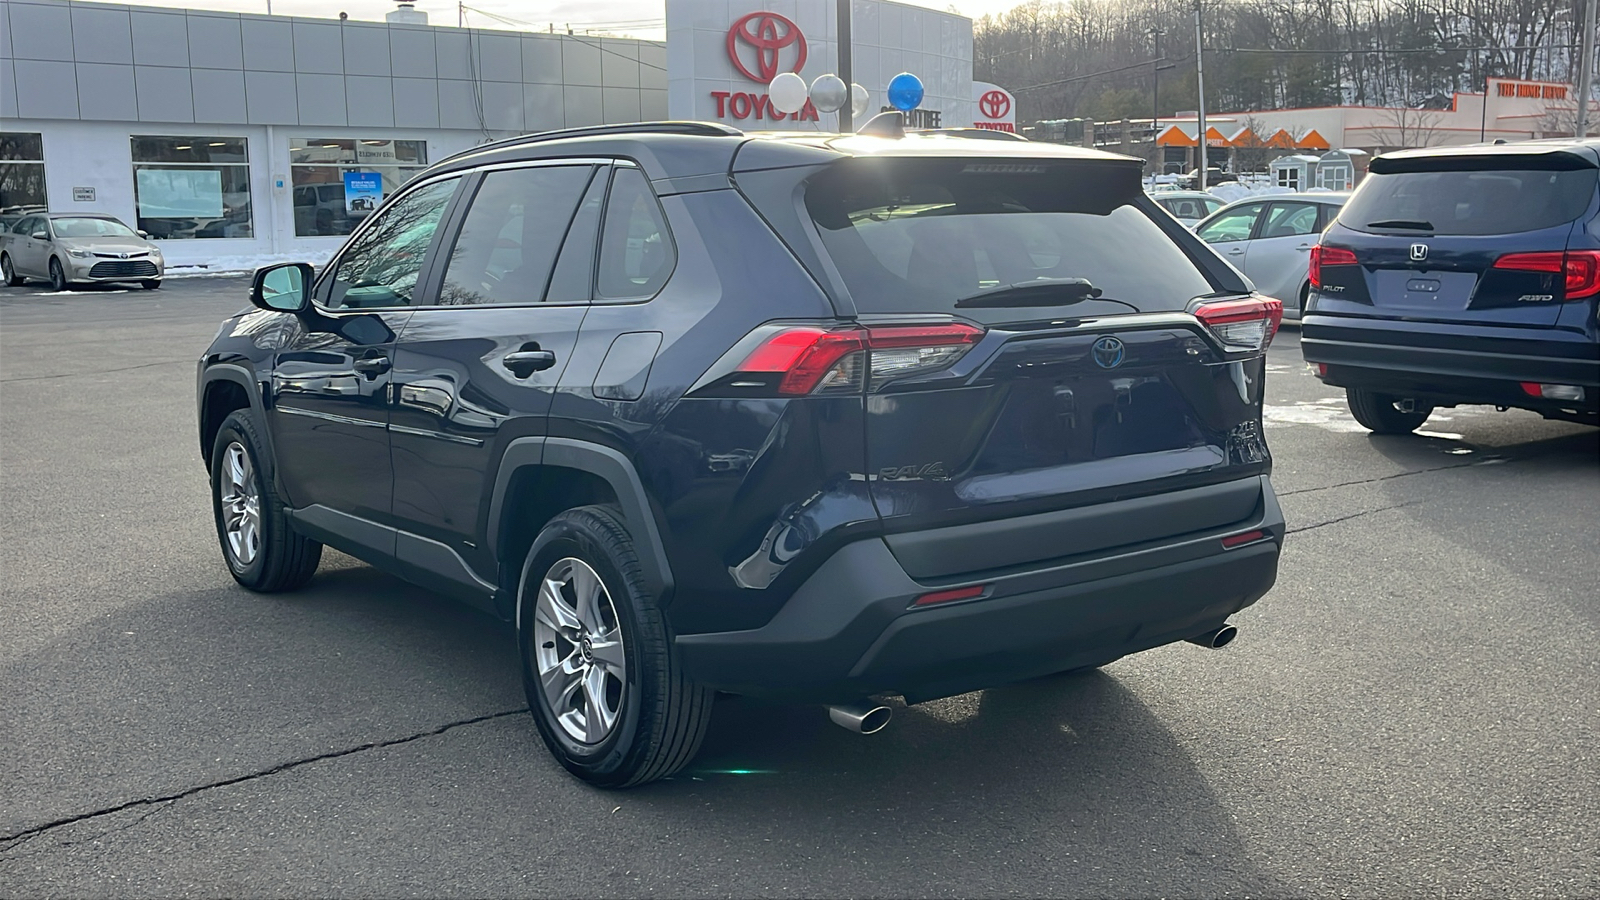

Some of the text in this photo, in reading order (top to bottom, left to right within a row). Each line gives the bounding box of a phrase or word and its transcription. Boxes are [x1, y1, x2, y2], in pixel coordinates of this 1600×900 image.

[1497, 83, 1515, 97] THE
[1517, 84, 1541, 98] HOME
[711, 92, 820, 121] TOYOA
[1518, 294, 1553, 302] AWD
[878, 461, 948, 481] RAV4
